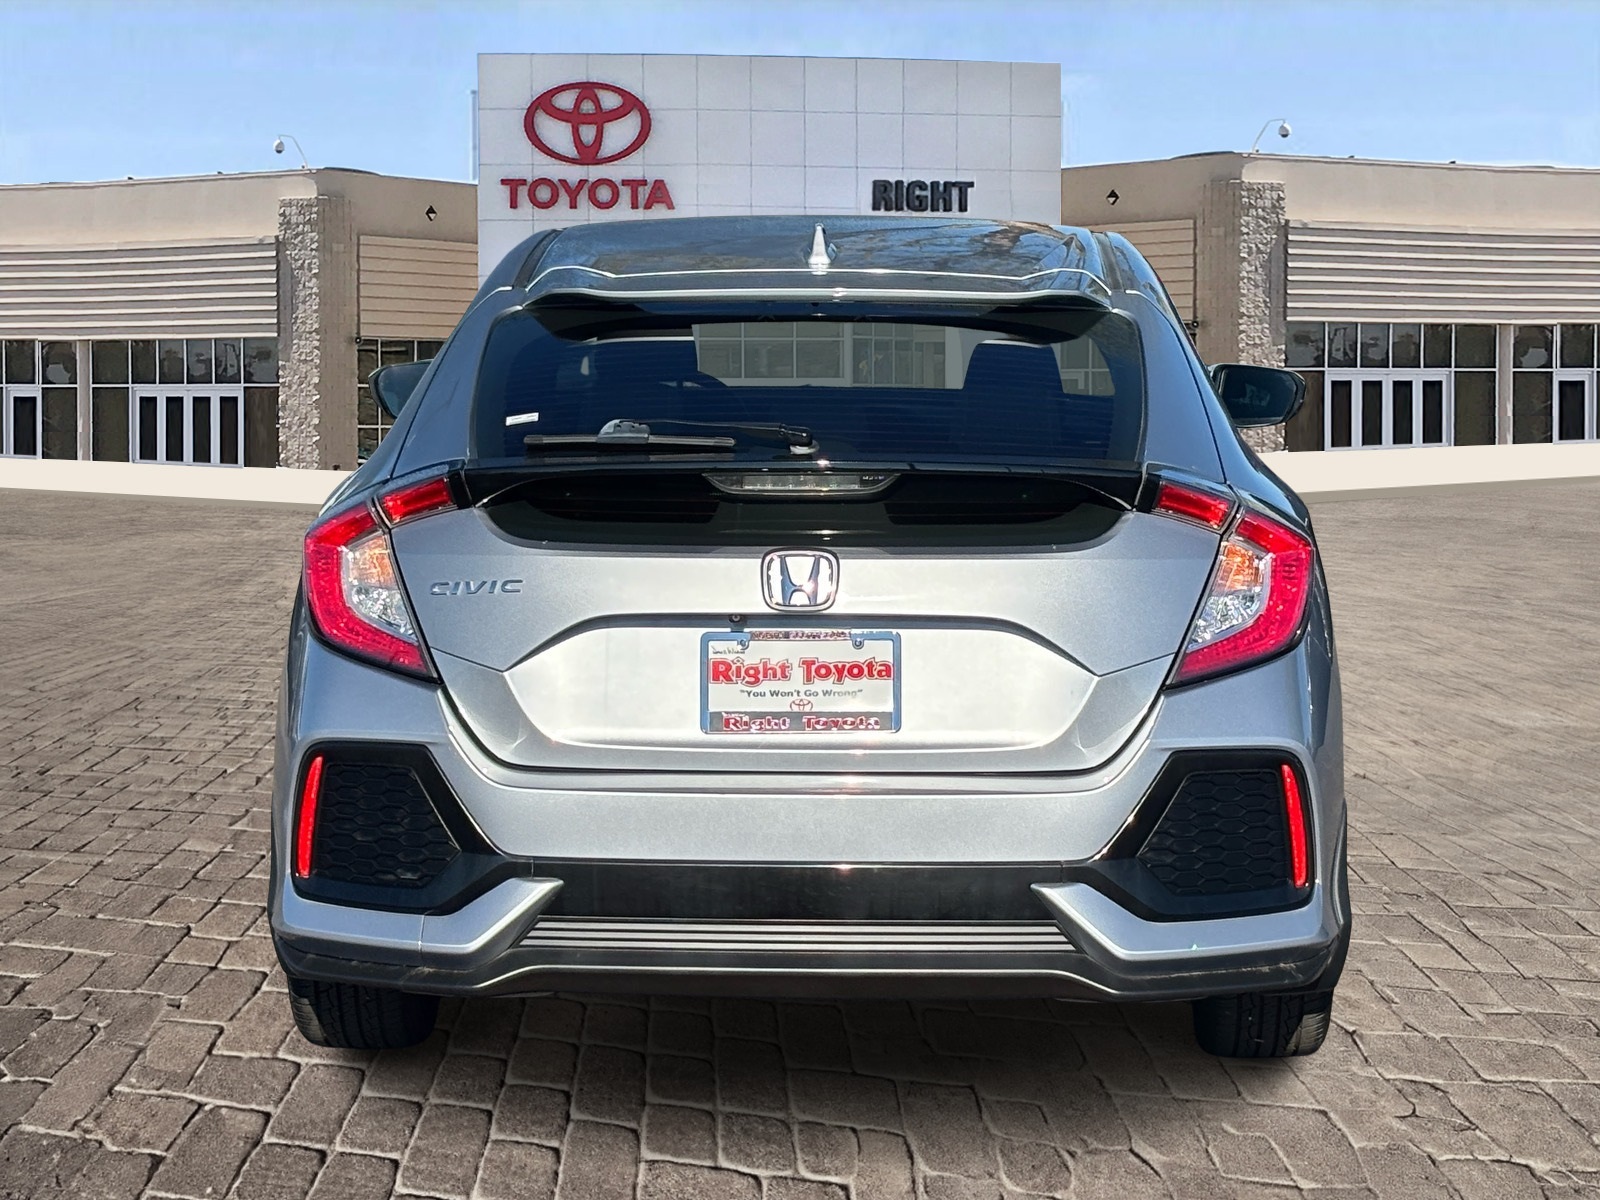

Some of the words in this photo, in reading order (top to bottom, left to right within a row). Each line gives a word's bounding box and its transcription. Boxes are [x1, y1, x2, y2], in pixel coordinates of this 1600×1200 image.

[501, 178, 675, 210] TOYOTA
[872, 179, 975, 213] RIGHT
[430, 579, 523, 595] CIVIC
[709, 658, 792, 687] Right
[799, 657, 893, 685] Toyota
[769, 689, 801, 698] Won't
[804, 689, 819, 698] Go
[723, 714, 790, 732] Right
[802, 715, 880, 731] Toyota
